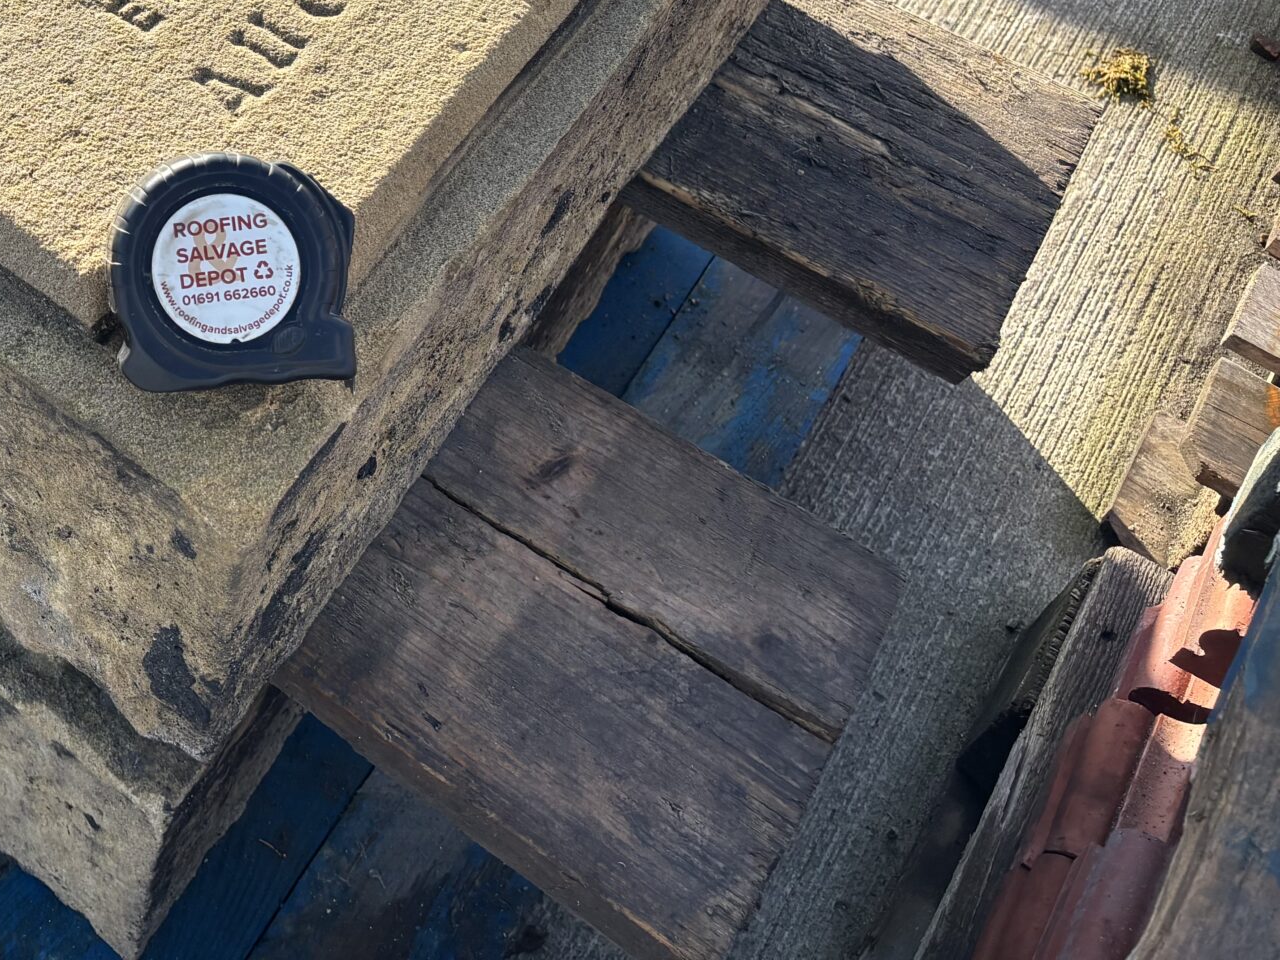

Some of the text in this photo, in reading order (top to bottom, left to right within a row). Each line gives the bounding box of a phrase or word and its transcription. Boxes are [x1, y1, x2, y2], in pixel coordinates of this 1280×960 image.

[173, 212, 269, 239] ROOFING
[176, 238, 268, 264] SALVAGE
[179, 267, 248, 290] DEPOT
[161, 264, 293, 335] www.roofingandsalvagedepot.co.uk
[182, 285, 276, 306] 01691 662660
